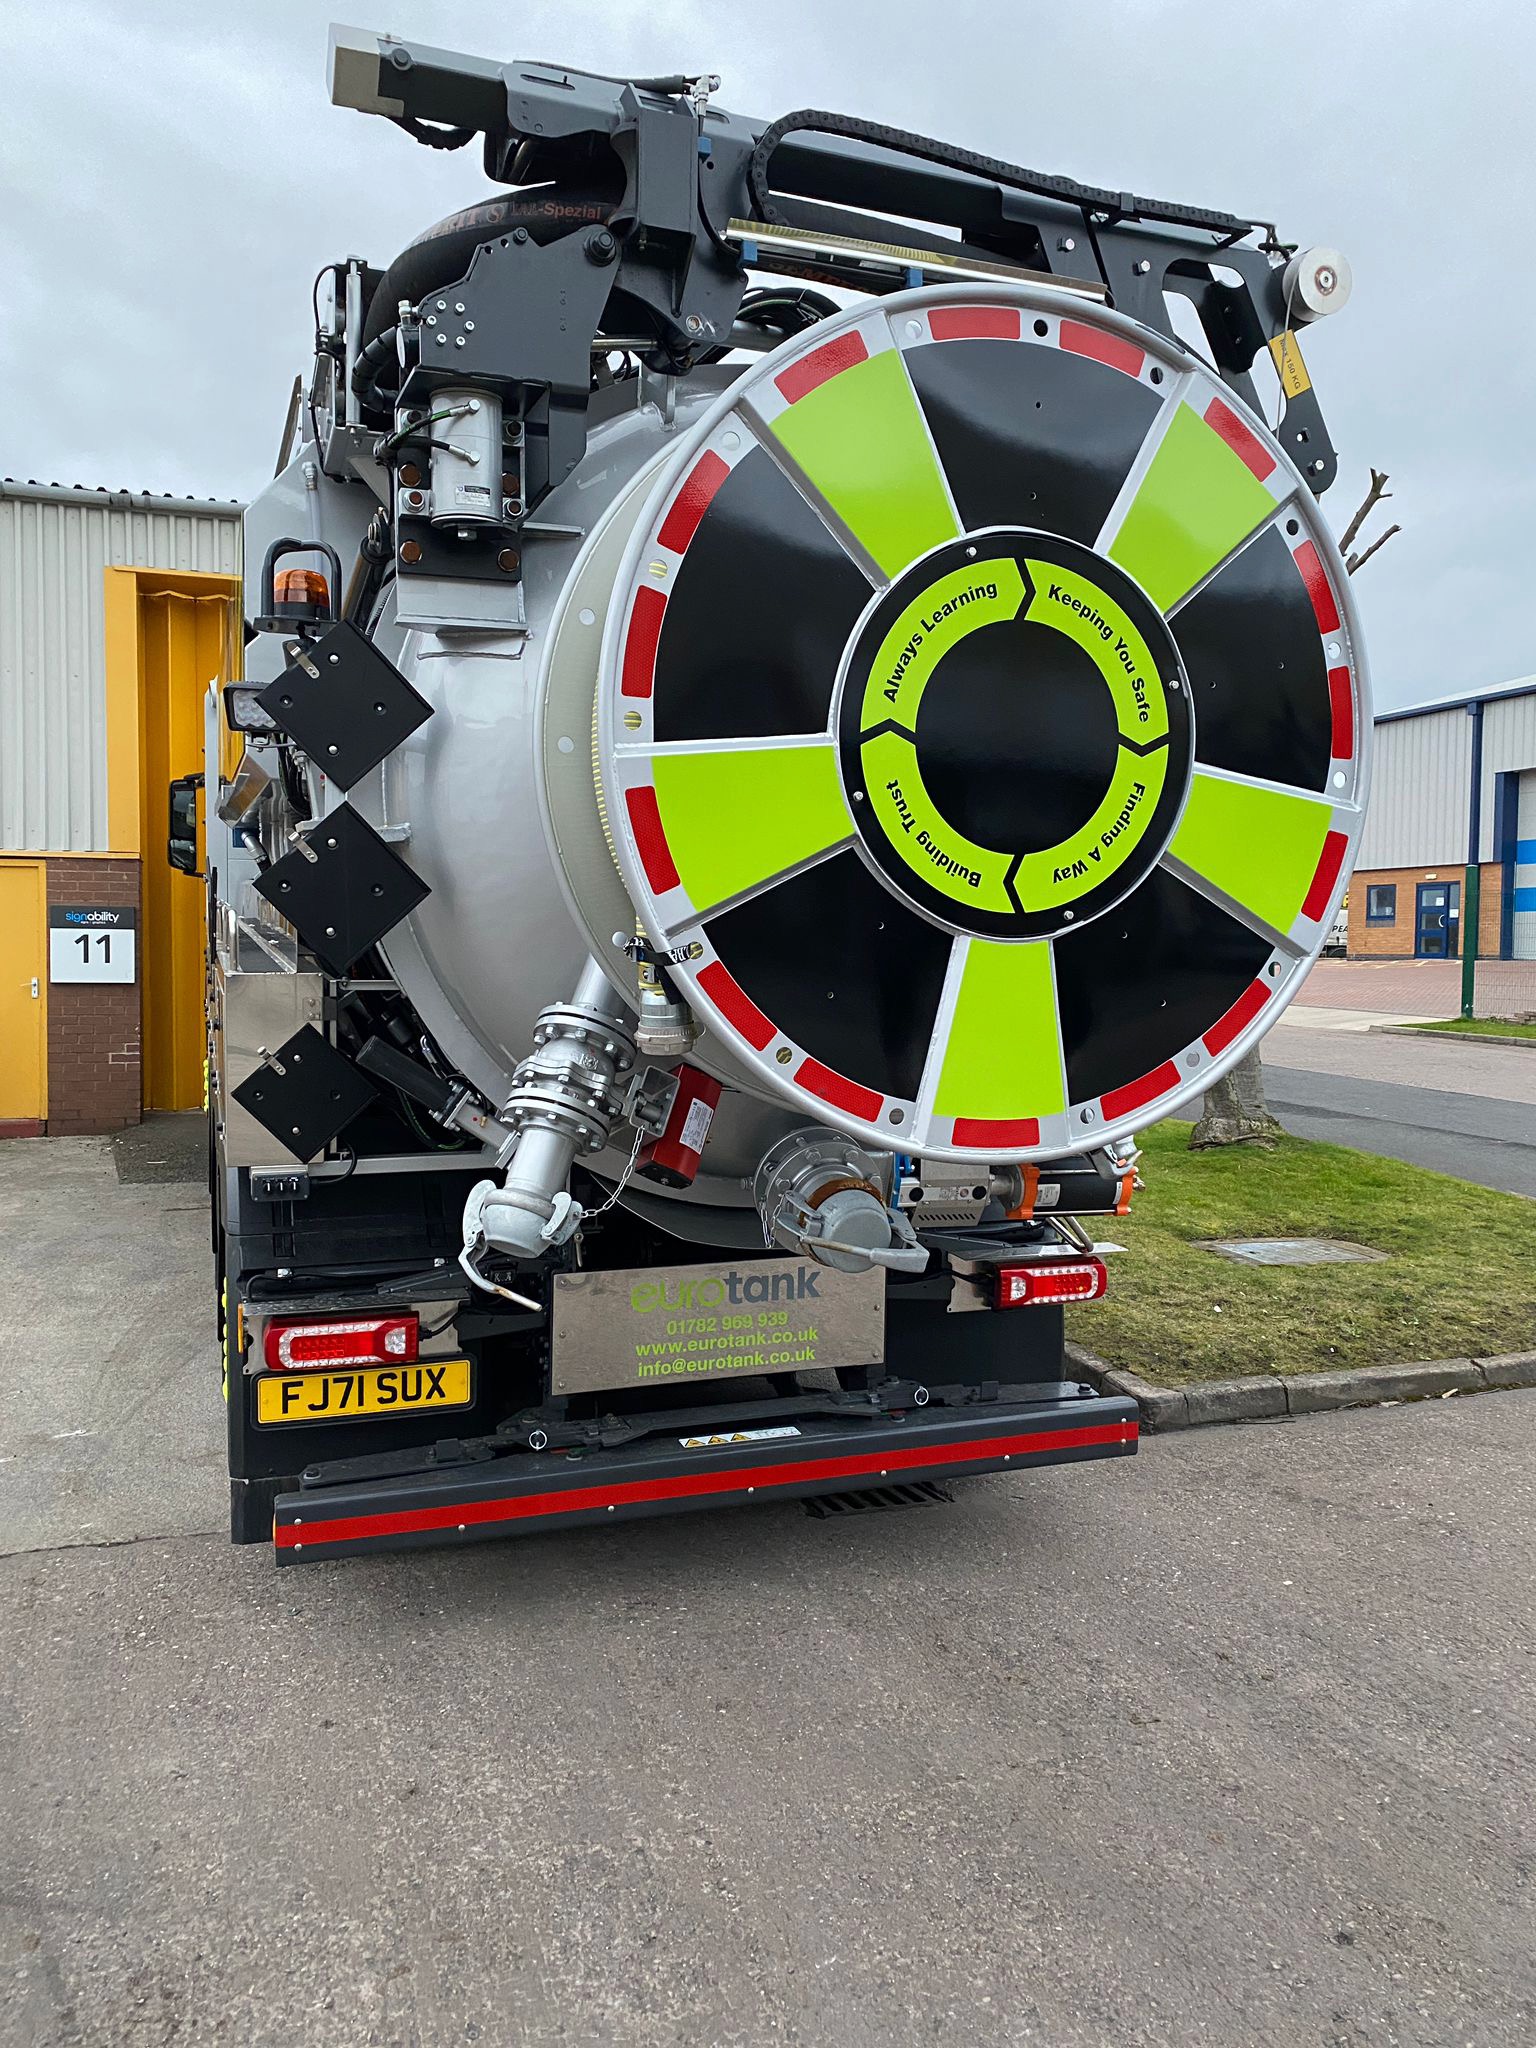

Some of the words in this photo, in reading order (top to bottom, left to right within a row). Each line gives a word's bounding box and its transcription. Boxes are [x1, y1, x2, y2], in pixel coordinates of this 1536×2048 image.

[1286, 358, 1296, 374] 150
[1292, 375, 1301, 390] KG
[883, 632, 924, 704] Always
[920, 583, 998, 633] Learning
[1048, 583, 1114, 641] Keeping
[1114, 636, 1137, 675] You
[1132, 677, 1151, 723] Safe
[886, 779, 916, 834] Trust
[1100, 782, 1146, 848] Finding
[916, 830, 982, 888] Building
[1088, 846, 1102, 863] A
[1053, 859, 1089, 884] Way
[65, 911, 119, 923] signability
[74, 934, 110, 963] 11
[630, 1266, 821, 1313] eurotank
[666, 1317, 717, 1336] 01782
[722, 1314, 753, 1331] 969
[758, 1311, 789, 1328] 939
[635, 1326, 819, 1357] www.eurotank.co.uk
[638, 1345, 816, 1377] info@eurotank.co.uk
[281, 1375, 365, 1415] FJ71
[376, 1367, 446, 1405] SUX
